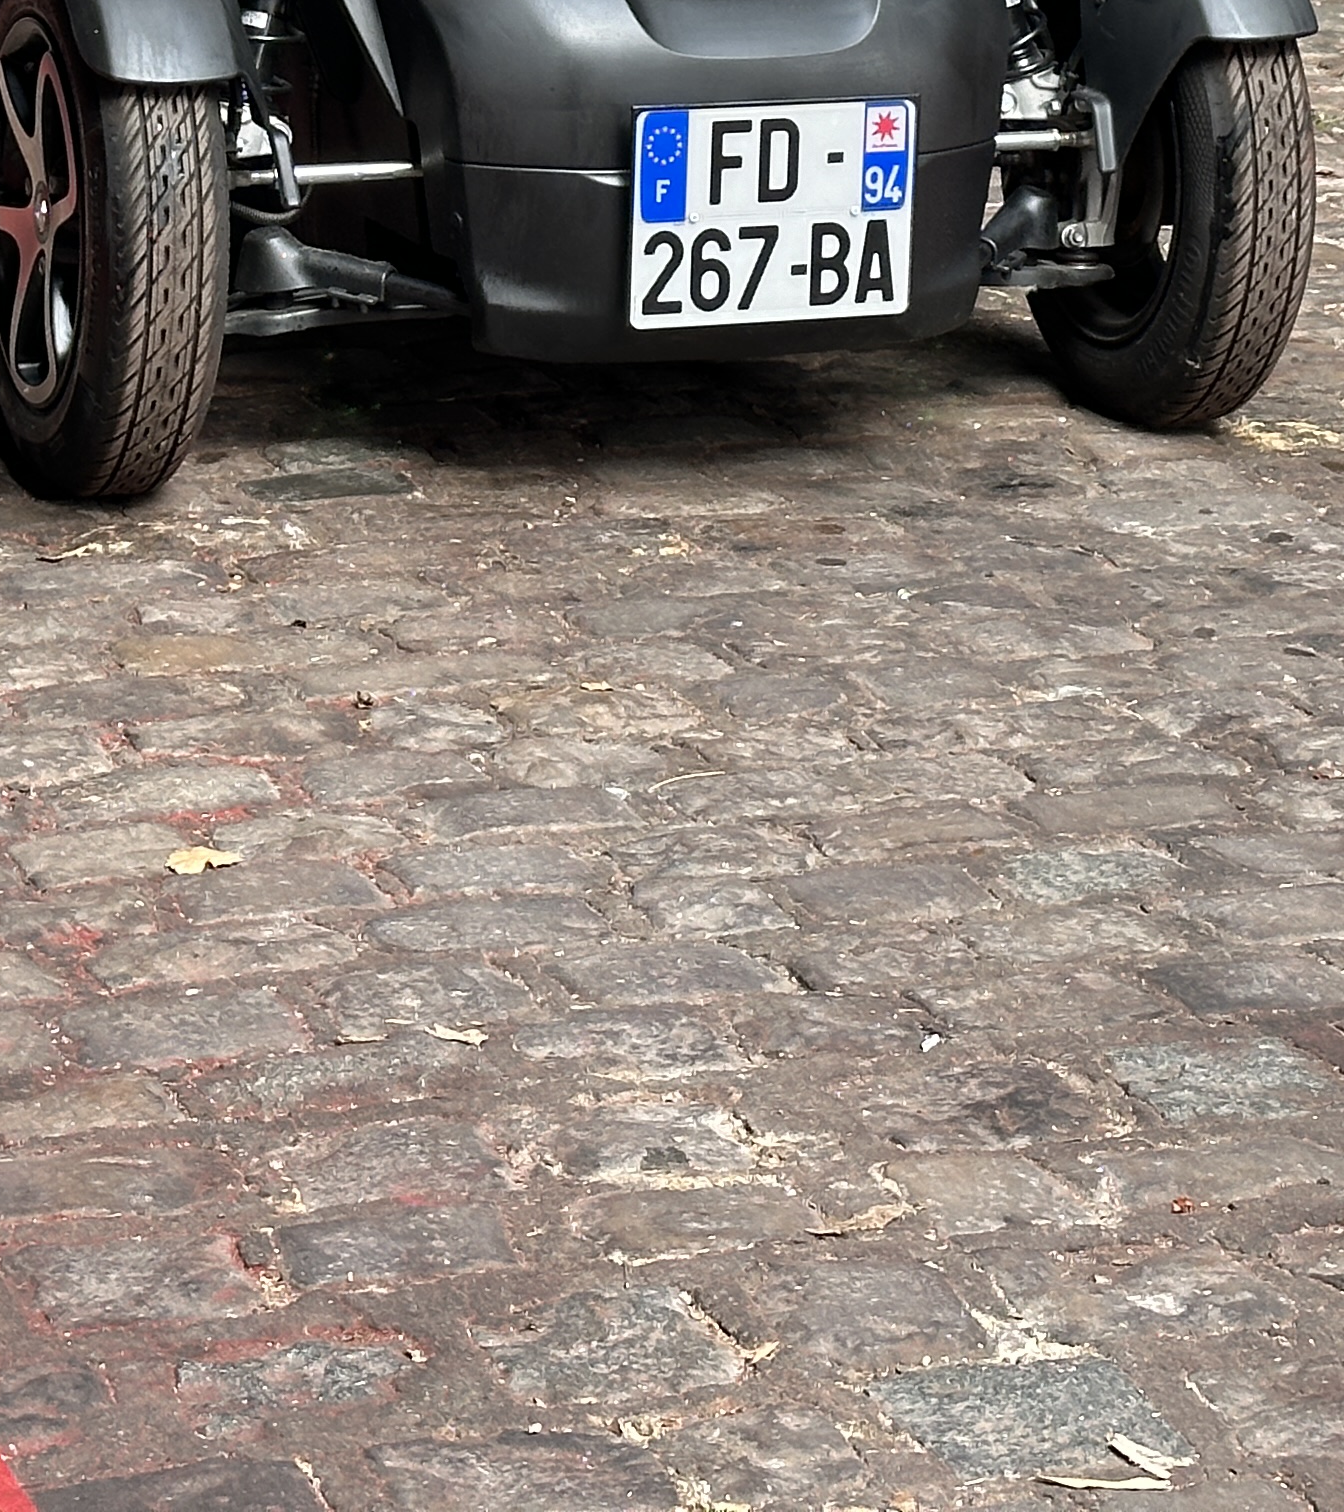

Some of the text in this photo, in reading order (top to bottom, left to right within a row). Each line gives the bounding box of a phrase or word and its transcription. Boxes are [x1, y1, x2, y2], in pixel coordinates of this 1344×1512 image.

[655, 178, 671, 204] F
[863, 164, 903, 204] 94
[641, 219, 895, 316] 267-BA
